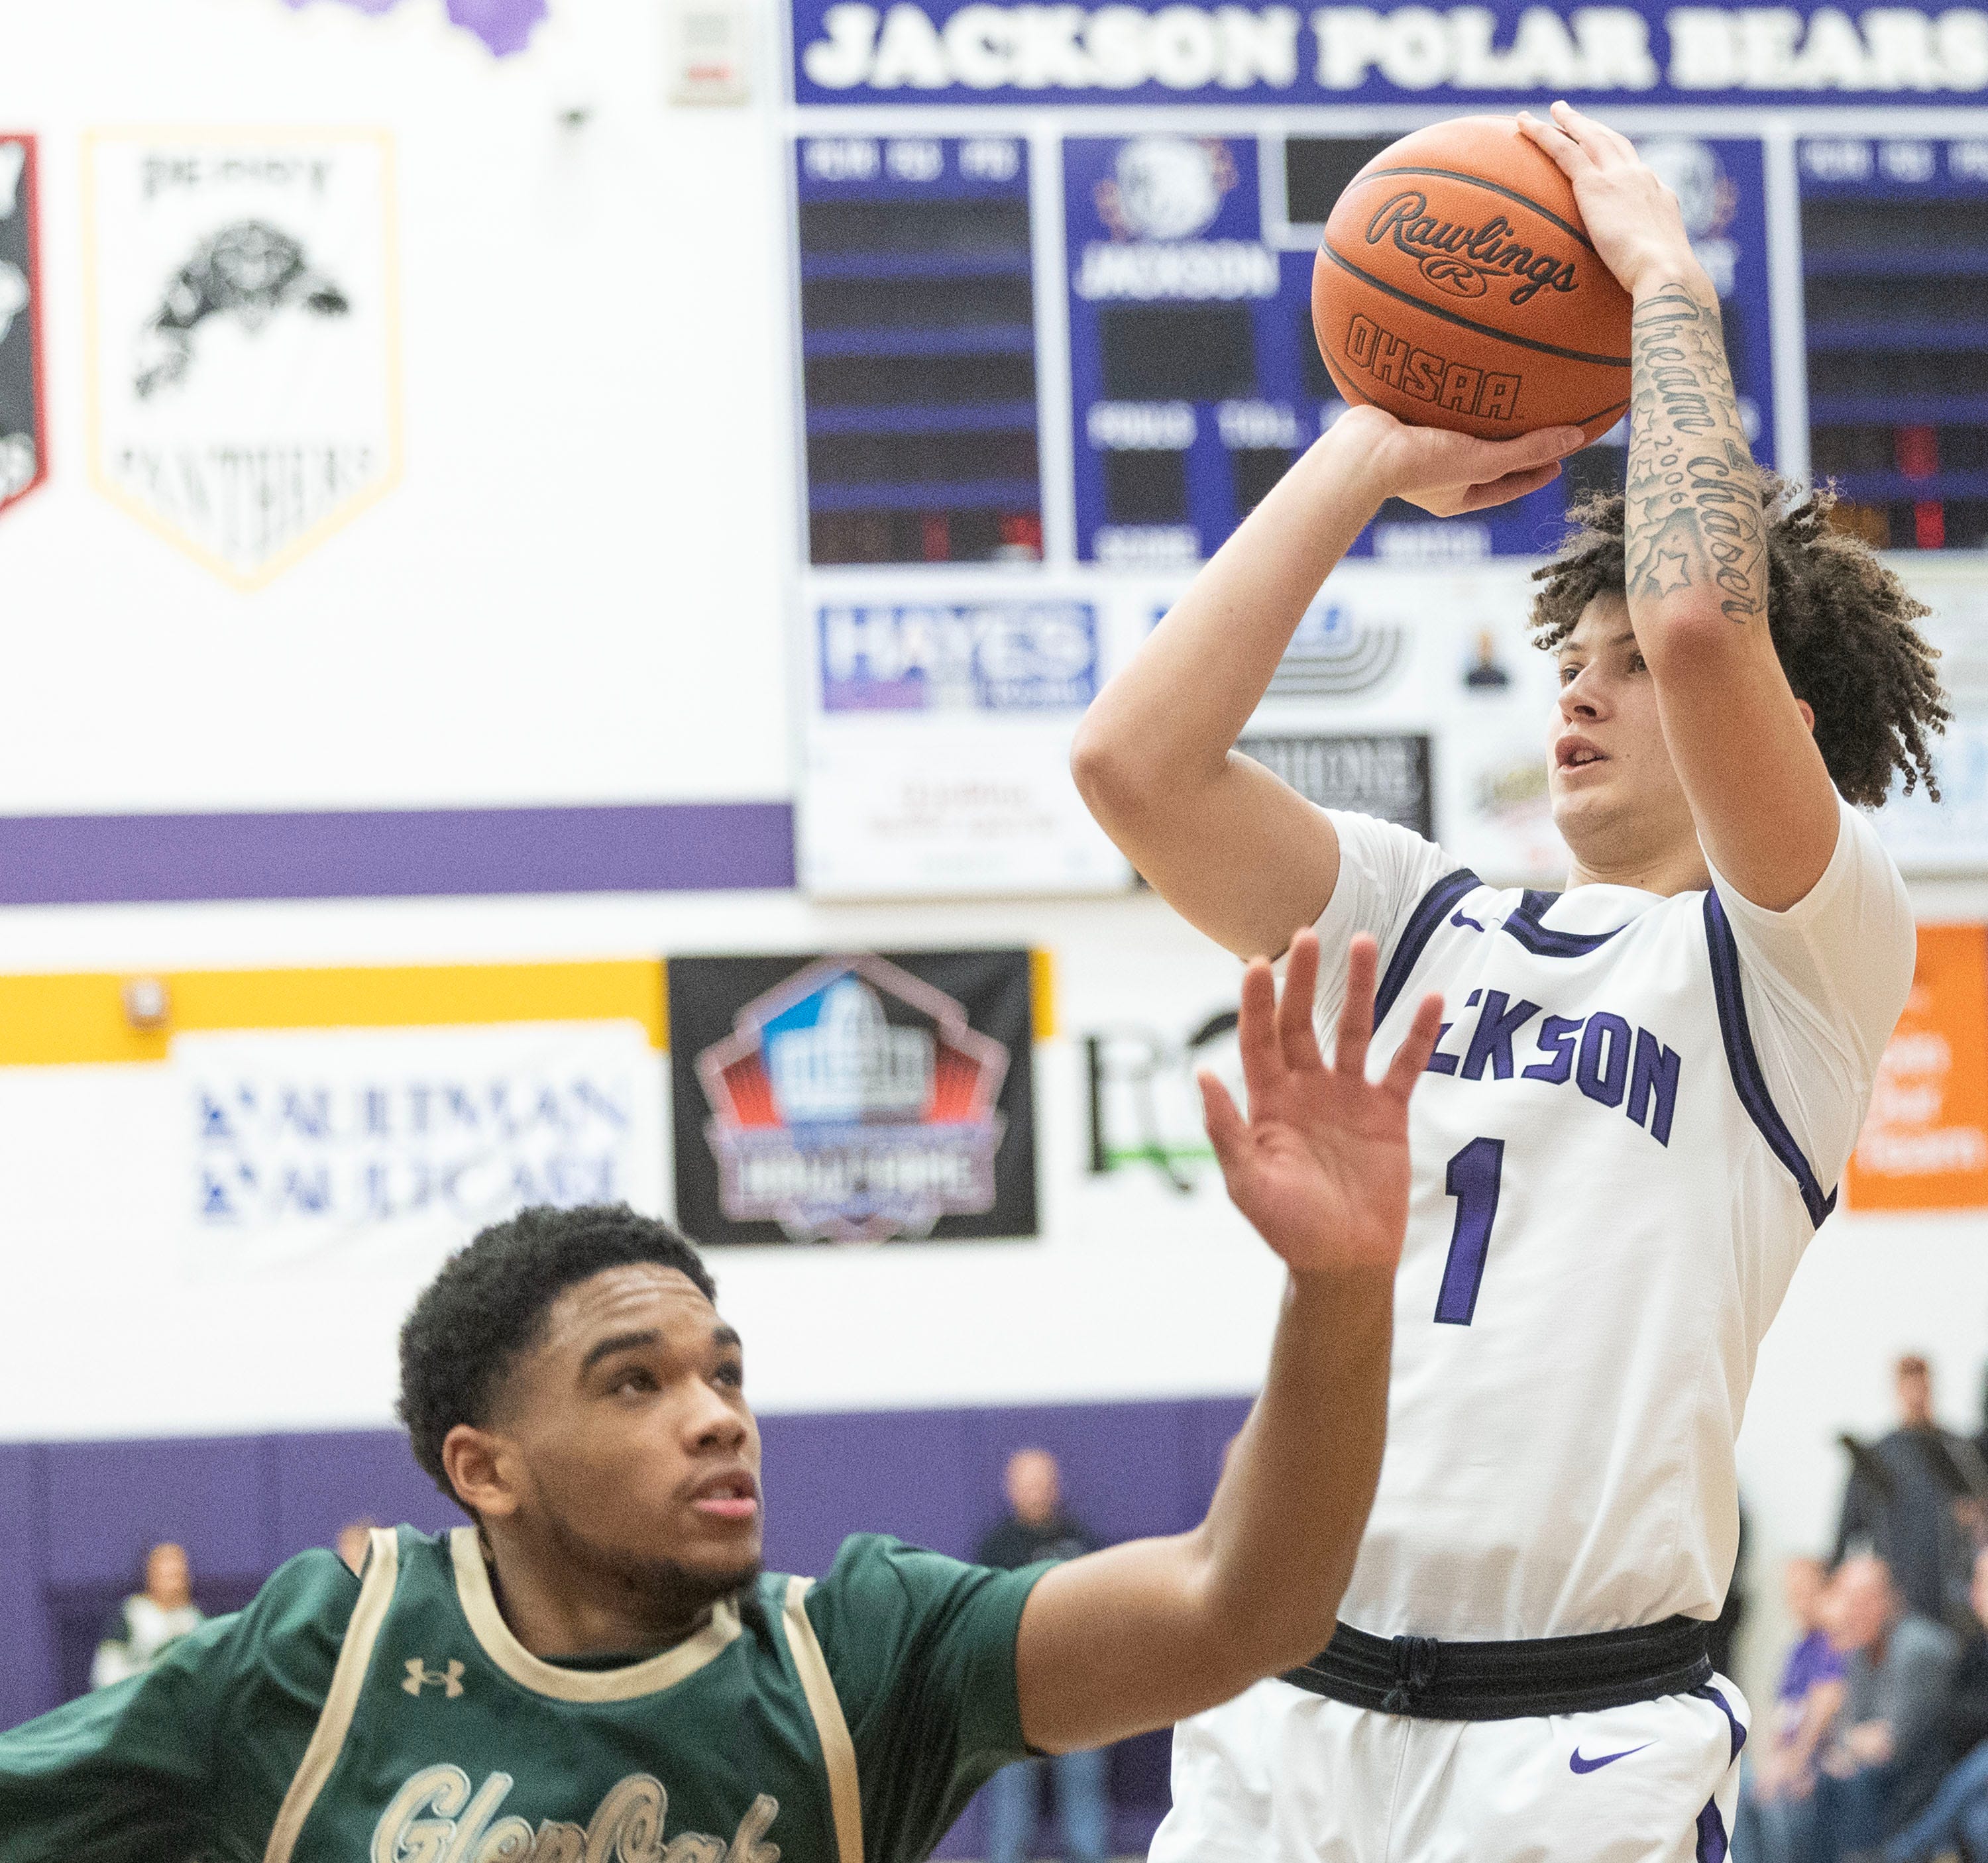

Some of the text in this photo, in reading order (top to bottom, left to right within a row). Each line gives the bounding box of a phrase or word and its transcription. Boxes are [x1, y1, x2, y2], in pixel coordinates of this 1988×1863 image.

[804, 7, 1988, 91] JACKSON POLAR BEARS
[1365, 191, 1579, 305] Rawlings
[1345, 313, 1521, 421] OHSAA
[1433, 1136, 1506, 1327] 1
